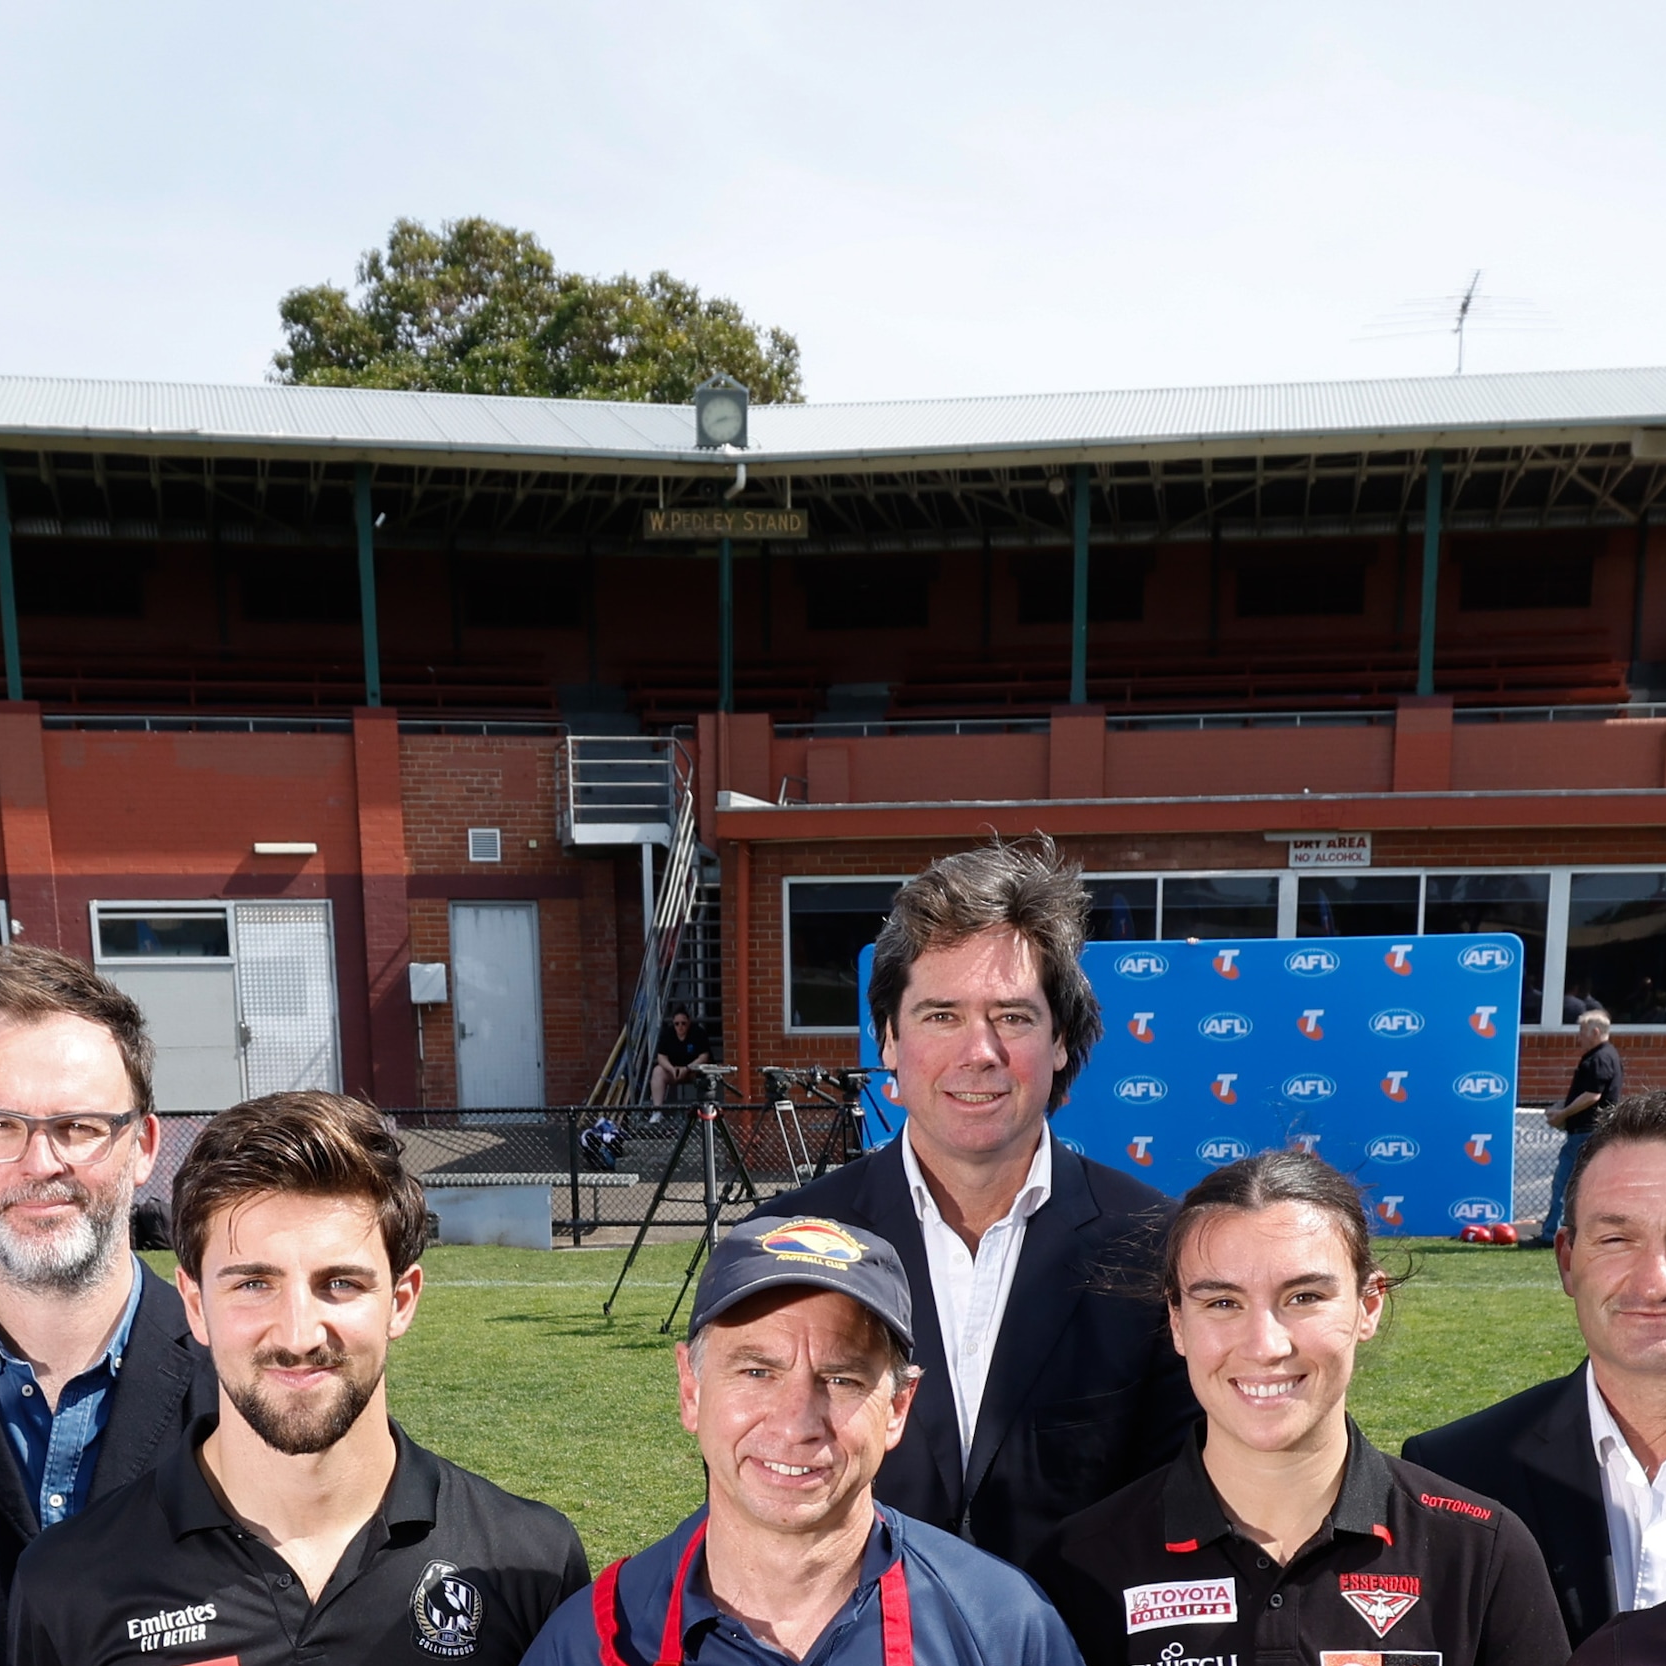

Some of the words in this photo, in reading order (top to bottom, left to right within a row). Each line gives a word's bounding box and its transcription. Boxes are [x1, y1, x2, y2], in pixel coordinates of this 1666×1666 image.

[650, 511, 734, 532] W.PEDLEY
[743, 511, 801, 532] STAND
[1293, 839, 1323, 849] DRY
[1327, 836, 1367, 849] AREA
[1294, 852, 1311, 863] NO
[1314, 851, 1366, 863] ALCOHOL
[1290, 955, 1335, 970] AFL
[1463, 950, 1509, 965] AFL
[1119, 958, 1164, 974] AFL
[1204, 1019, 1247, 1034] AFL
[1374, 1015, 1419, 1030] AFL
[1119, 1082, 1163, 1097] AFL
[1288, 1081, 1331, 1096] AFL
[1459, 1078, 1503, 1094] AFL
[1202, 1144, 1245, 1159] AFL
[1371, 1142, 1415, 1157] AFL
[1454, 1204, 1499, 1219] AFL
[776, 1253, 824, 1266] FOOTBALL
[824, 1259, 848, 1272] CLUB
[1339, 1573, 1421, 1595] ESSENDON
[1151, 1586, 1229, 1605] TOYOTA
[127, 1603, 217, 1639] Emirates
[1136, 1604, 1226, 1623] FORKLIFTS
[140, 1633, 161, 1652] FLY
[163, 1623, 206, 1647] BETTER
[419, 1638, 474, 1656] COLLINGWOOD
